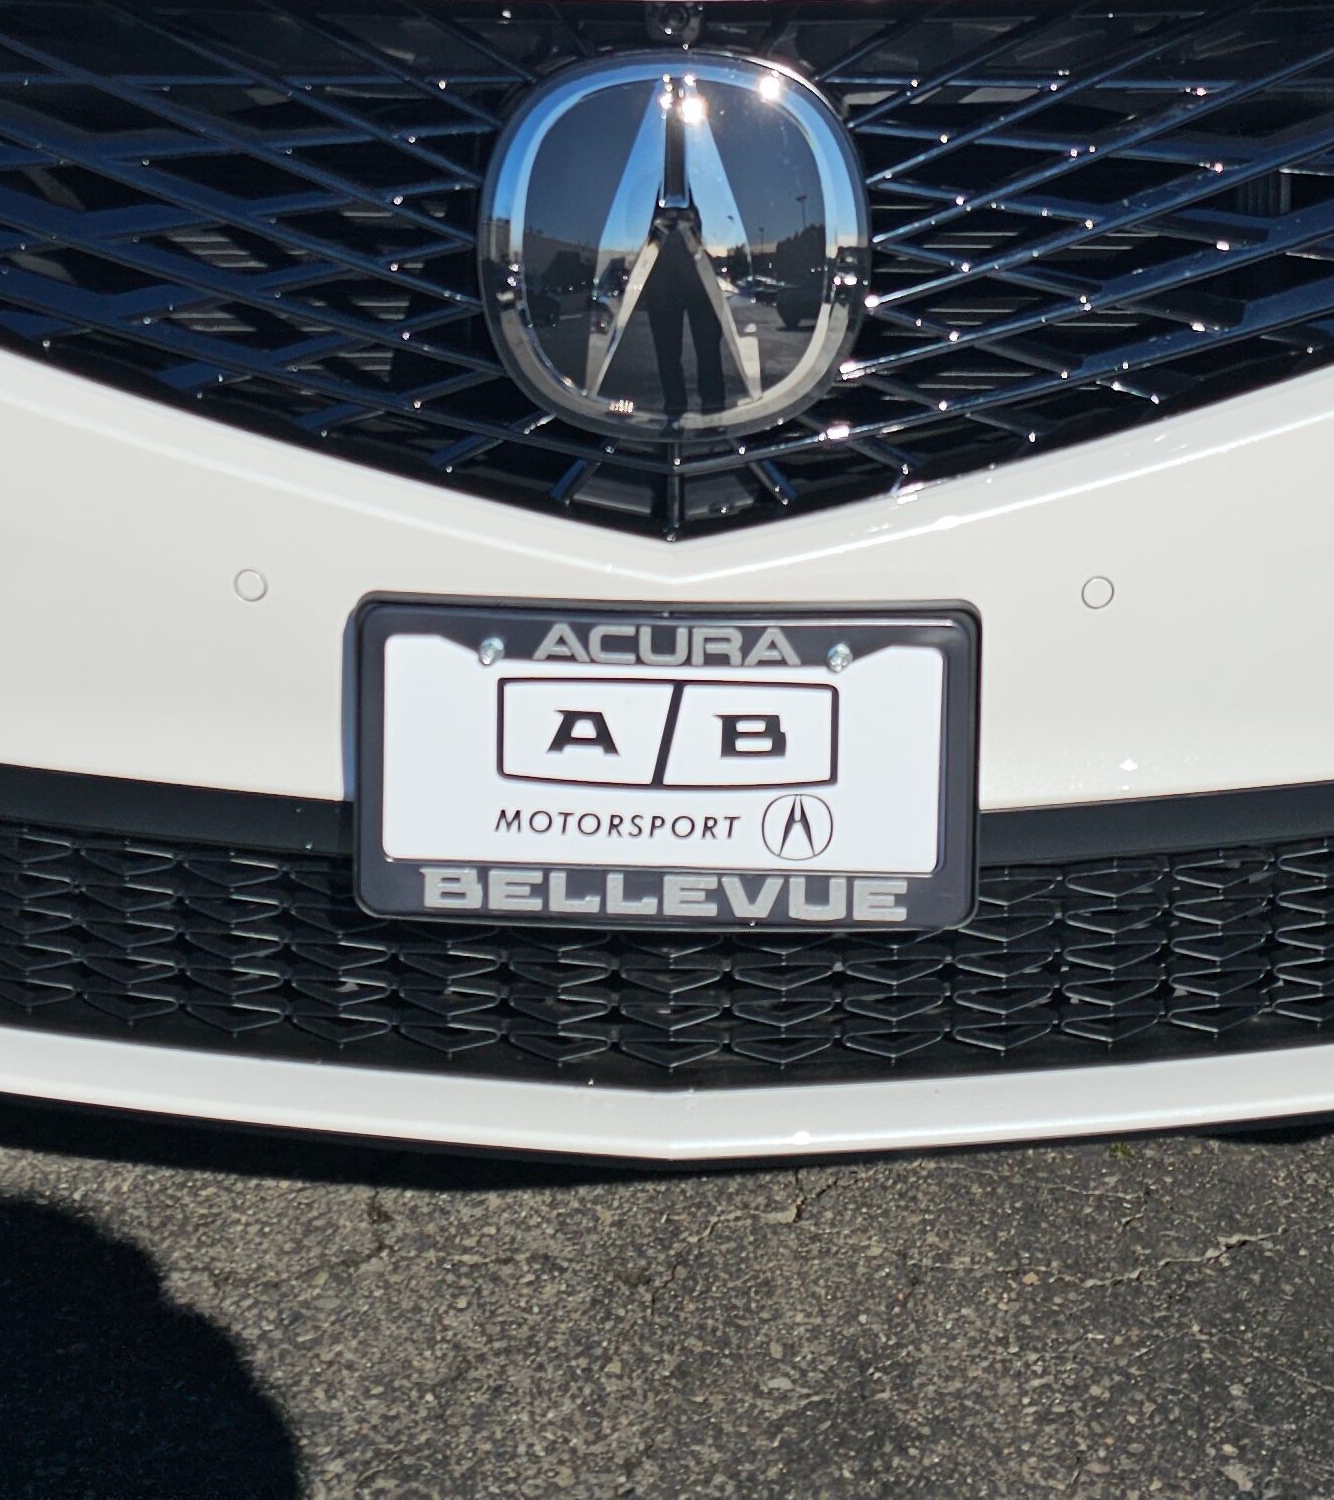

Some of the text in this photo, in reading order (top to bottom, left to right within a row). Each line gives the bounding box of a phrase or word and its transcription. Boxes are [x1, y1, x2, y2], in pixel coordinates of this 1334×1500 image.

[532, 623, 802, 667] ACURA
[494, 808, 742, 840] MOTORSPORT
[419, 867, 908, 922] BELLEVUE
